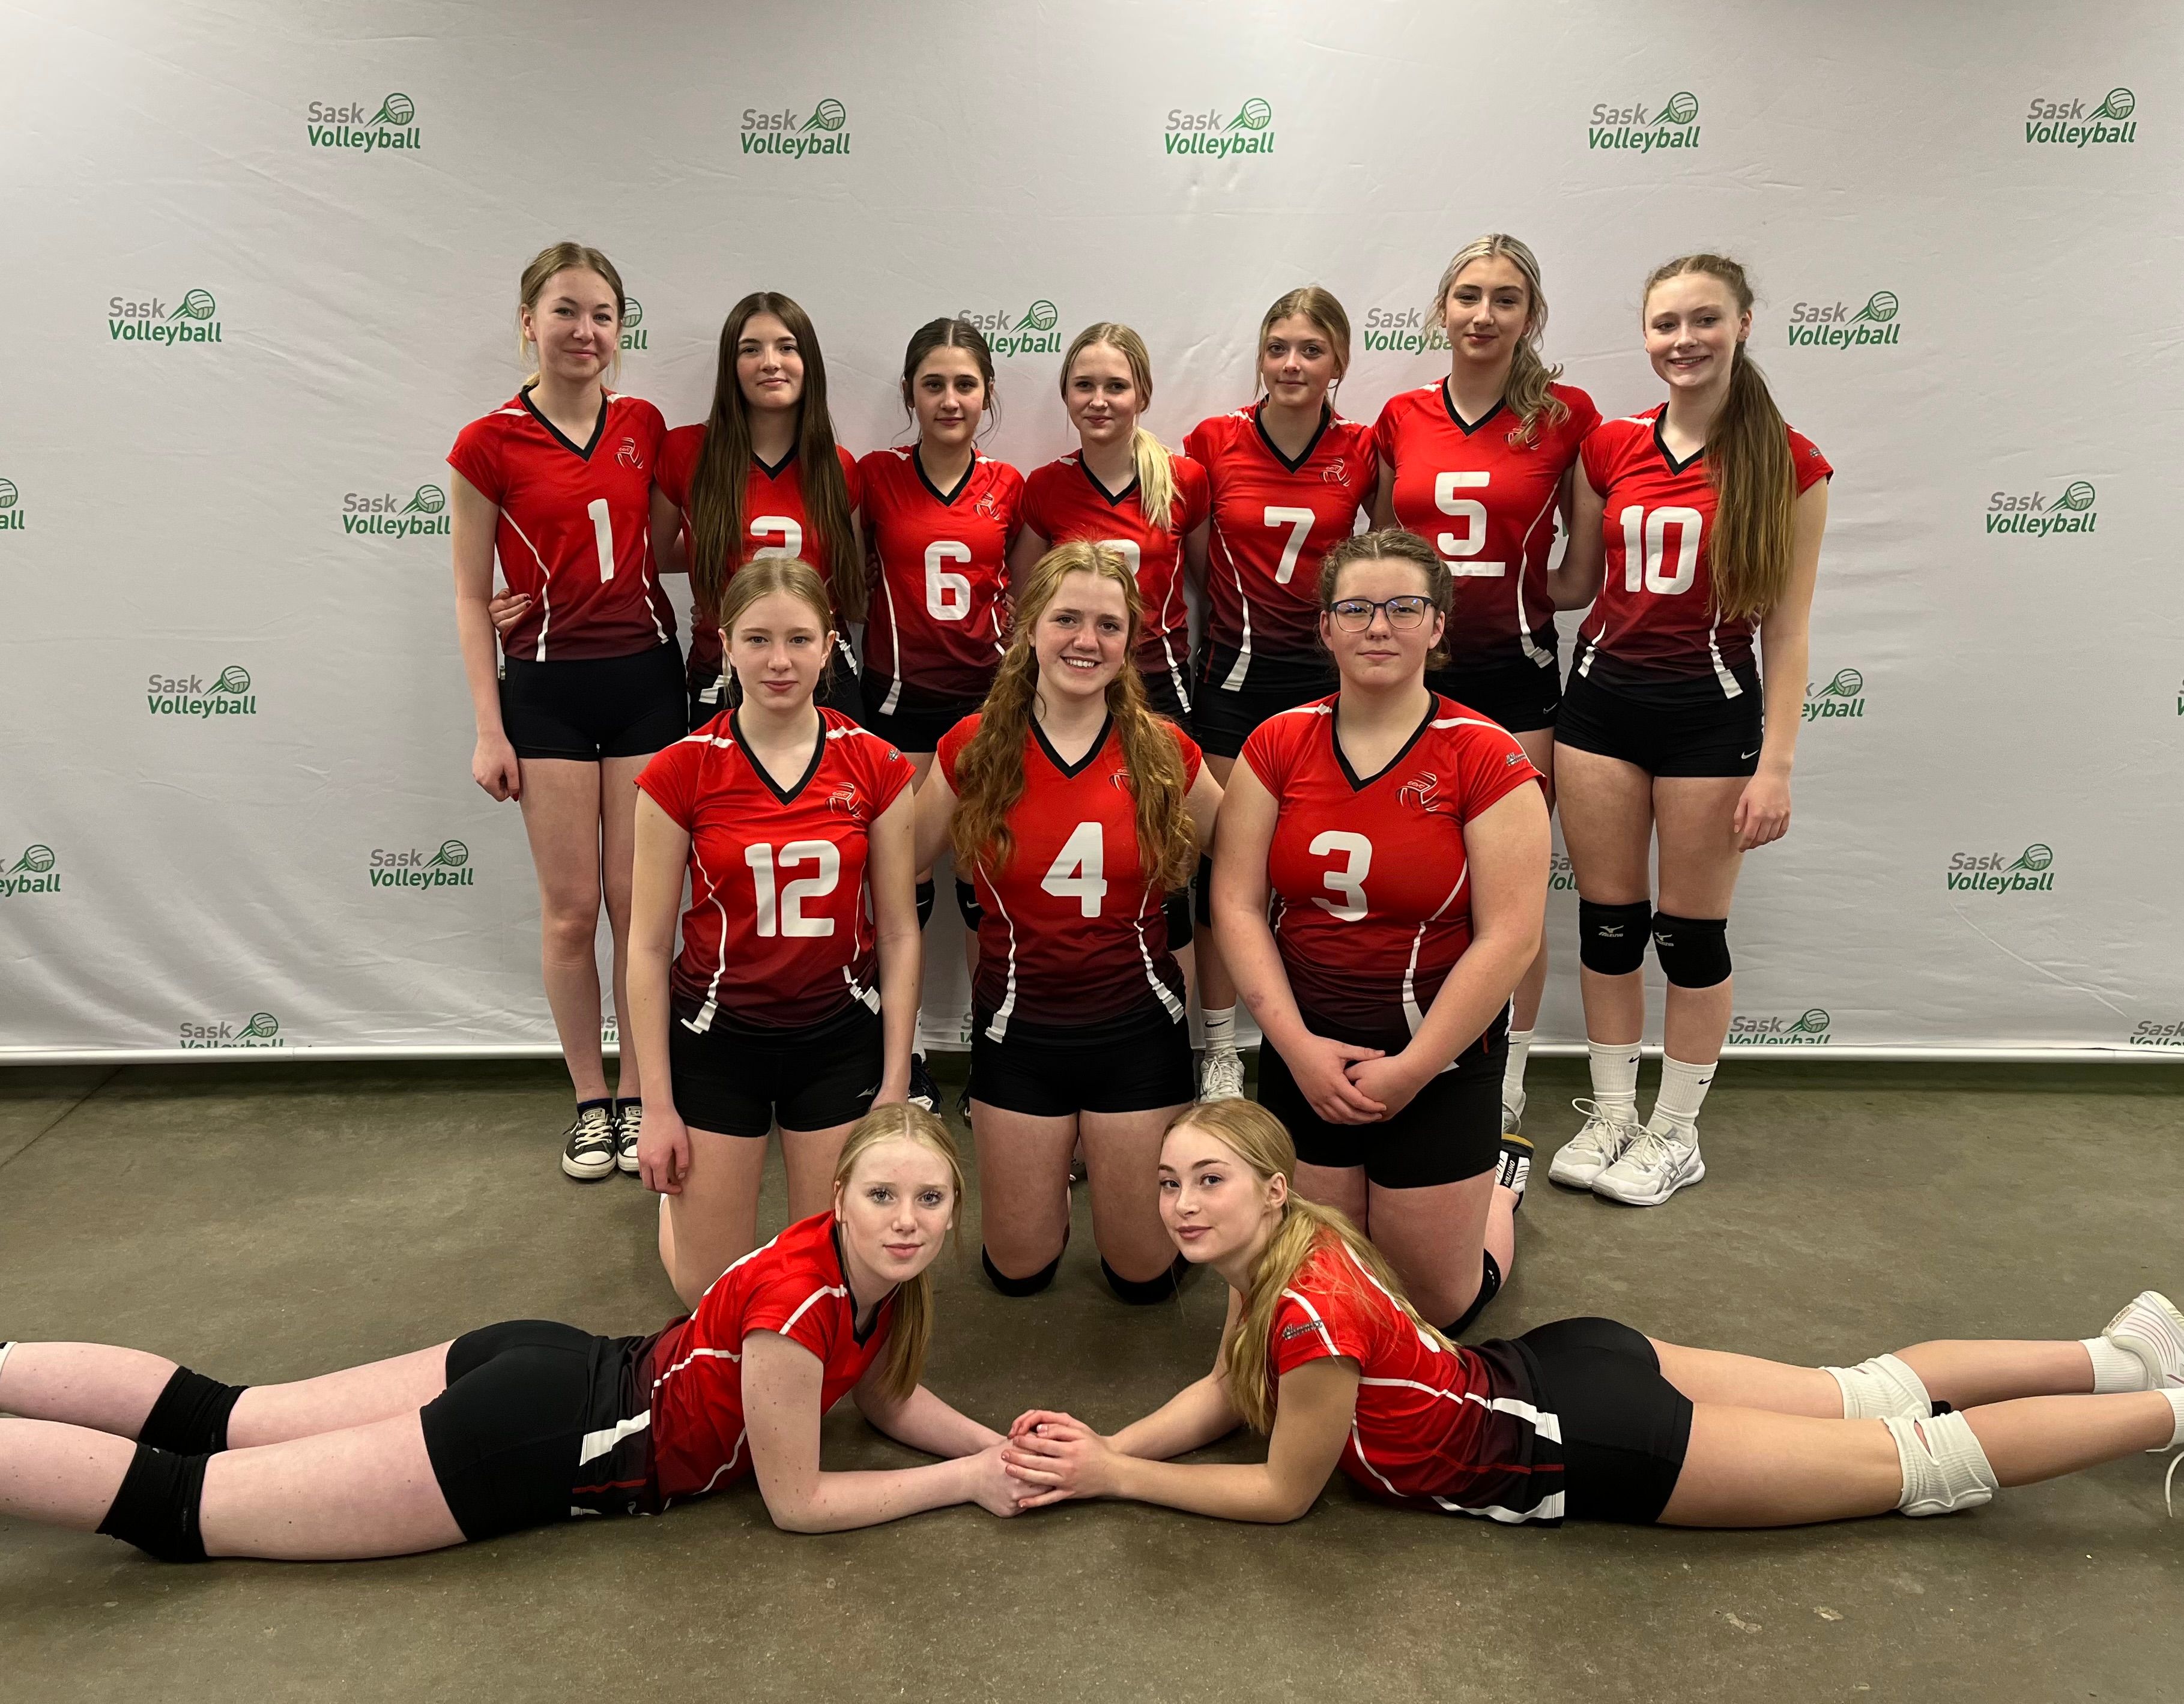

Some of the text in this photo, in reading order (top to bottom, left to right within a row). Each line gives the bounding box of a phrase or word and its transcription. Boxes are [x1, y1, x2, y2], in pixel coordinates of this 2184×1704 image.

[307, 101, 365, 124] Sask
[740, 109, 797, 131] Sask
[1166, 109, 1221, 131] Sask
[1590, 103, 1649, 125] Sask
[2027, 98, 2086, 120] Sask
[307, 125, 421, 153] Volleyball
[740, 132, 850, 159] Volleyball
[1164, 131, 1274, 159] Volleyball
[1588, 125, 1701, 154] Volleyball
[2025, 121, 2138, 148] Volleyball
[109, 297, 166, 319] Sask
[958, 309, 1011, 330] Sask
[1364, 307, 1422, 329] Sask
[1789, 301, 1849, 323] Sask
[109, 319, 223, 346] Volleyball
[1364, 330, 1453, 356] Volleyb
[1788, 324, 1901, 349] Volleyball
[983, 332, 1061, 358] leyball
[342, 492, 398, 513] Sask
[1434, 471, 1490, 556] 5
[1987, 491, 2045, 512] Sask
[342, 515, 450, 539] Volleyball
[1985, 512, 2097, 537] Volleyball
[587, 498, 614, 584] 1
[1264, 506, 1316, 585] 7
[1620, 505, 1703, 595] 10
[924, 540, 971, 621] 6
[147, 674, 203, 694] Sask
[147, 695, 256, 719] Volleyball
[1801, 698, 1865, 722] eyball
[369, 848, 424, 867] Sask
[1948, 852, 2006, 872] Sask
[369, 867, 474, 891] Volleyball
[1041, 821, 1107, 919] 4
[1308, 830, 1373, 922] 3
[0, 874, 61, 898] eyball
[744, 840, 840, 938] 12
[1947, 872, 2055, 895] Volleyball
[180, 1021, 232, 1039] Sask
[1729, 1016, 1783, 1033] Sask
[1504, 1159, 1516, 1186] MIZUNO
